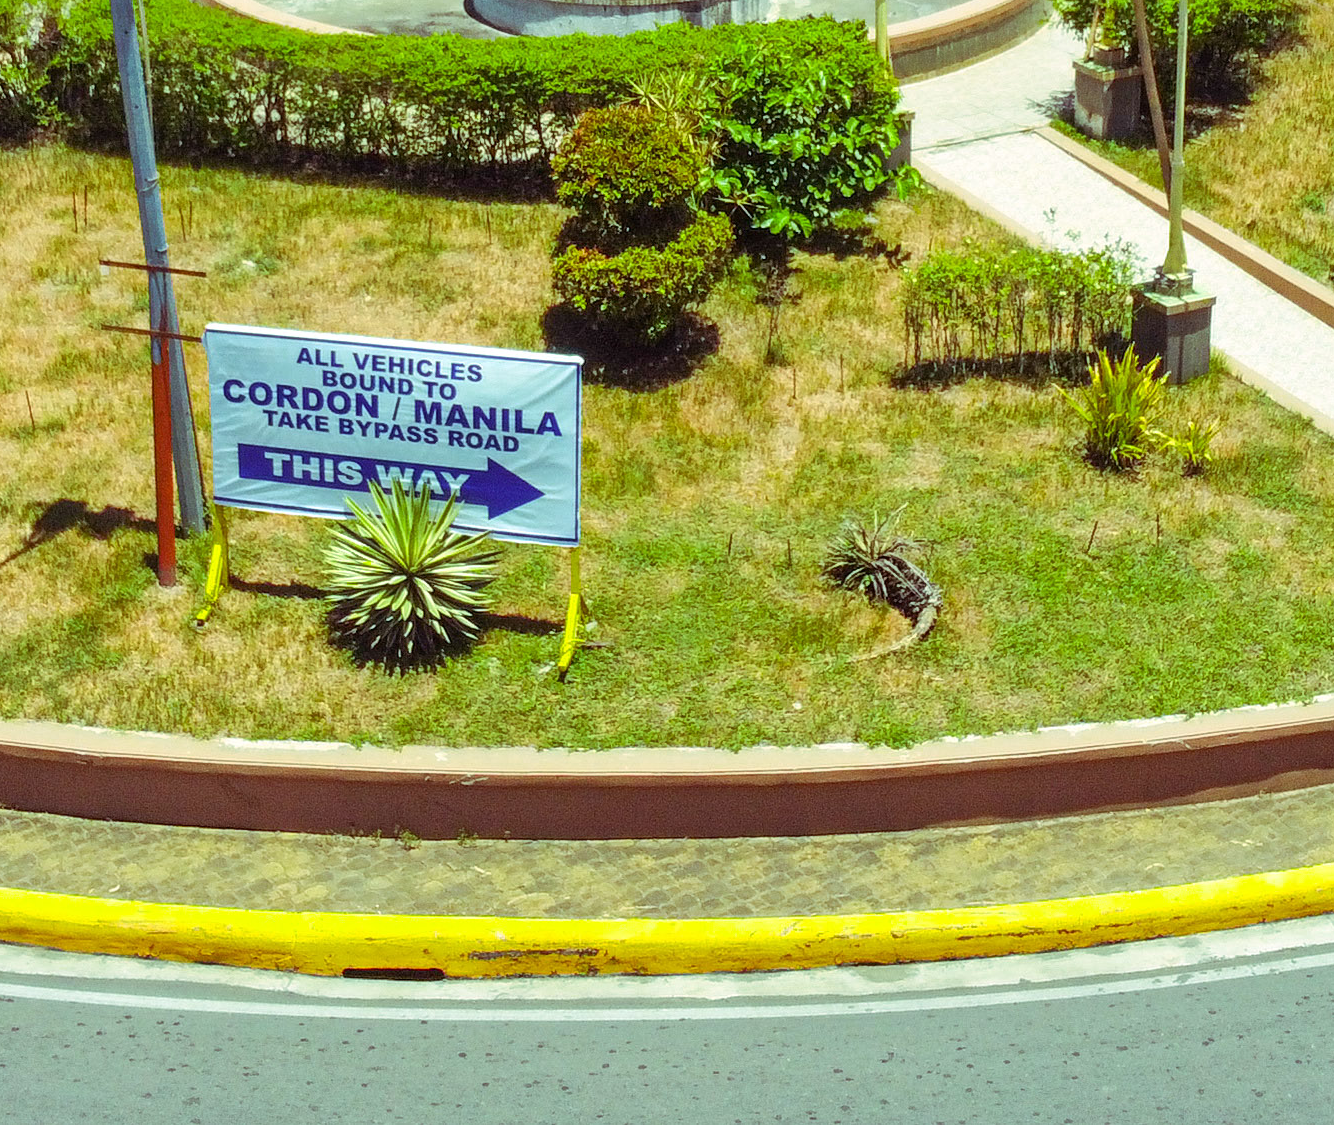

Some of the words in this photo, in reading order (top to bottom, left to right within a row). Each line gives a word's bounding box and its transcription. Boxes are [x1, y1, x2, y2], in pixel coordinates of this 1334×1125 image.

[296, 347, 344, 369] ALL
[352, 352, 483, 383] VEHICLES
[322, 370, 414, 397] BOUND
[423, 381, 457, 401] TO
[222, 379, 380, 419] CORDON
[391, 397, 402, 422] /
[414, 400, 563, 437] MANILA
[262, 409, 330, 433] TAKE
[338, 417, 439, 445] BYPASS
[448, 430, 520, 453] ROAD
[264, 452, 363, 487] THIS
[373, 464, 471, 497] WAY
